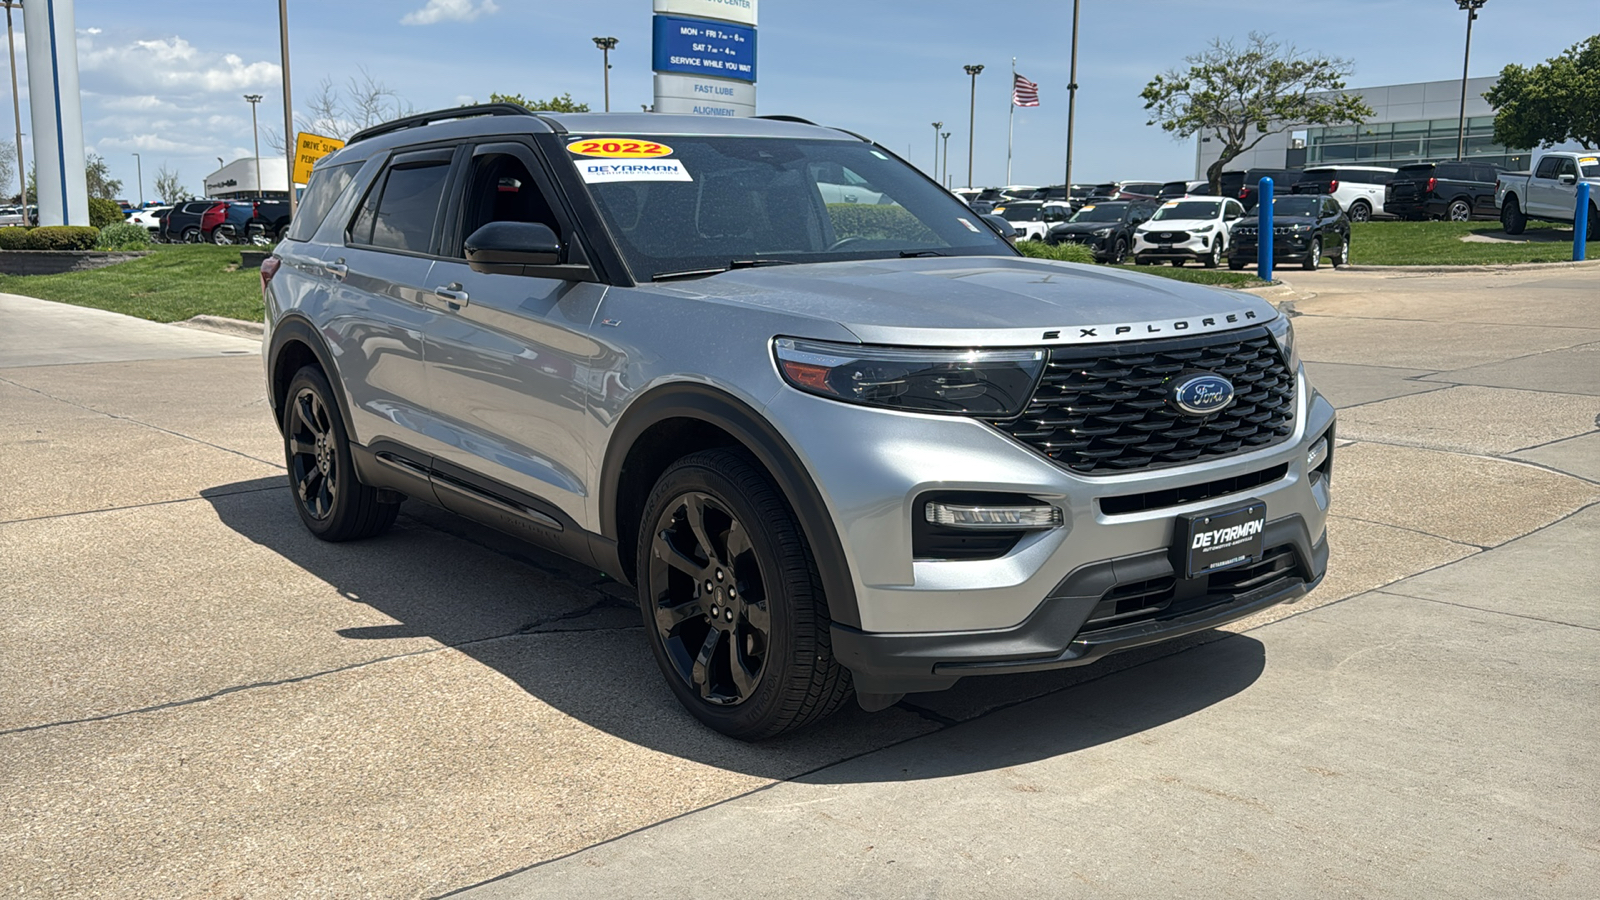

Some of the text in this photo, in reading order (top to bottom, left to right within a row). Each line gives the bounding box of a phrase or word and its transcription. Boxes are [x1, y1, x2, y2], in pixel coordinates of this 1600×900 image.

[680, 26, 698, 36] MON
[705, 29, 717, 39] FRI
[692, 43, 705, 52] SAT
[670, 56, 751, 72] SERVICE WHILE YOU WAIT
[694, 84, 734, 96] FAST LUBE
[693, 106, 735, 117] ALIGNMENT
[303, 140, 319, 151] DRIVE
[581, 142, 662, 154] 2022
[1042, 310, 1257, 340] EXPLORER
[1193, 382, 1224, 406] Ford
[1192, 518, 1264, 549] DEYARMAN
